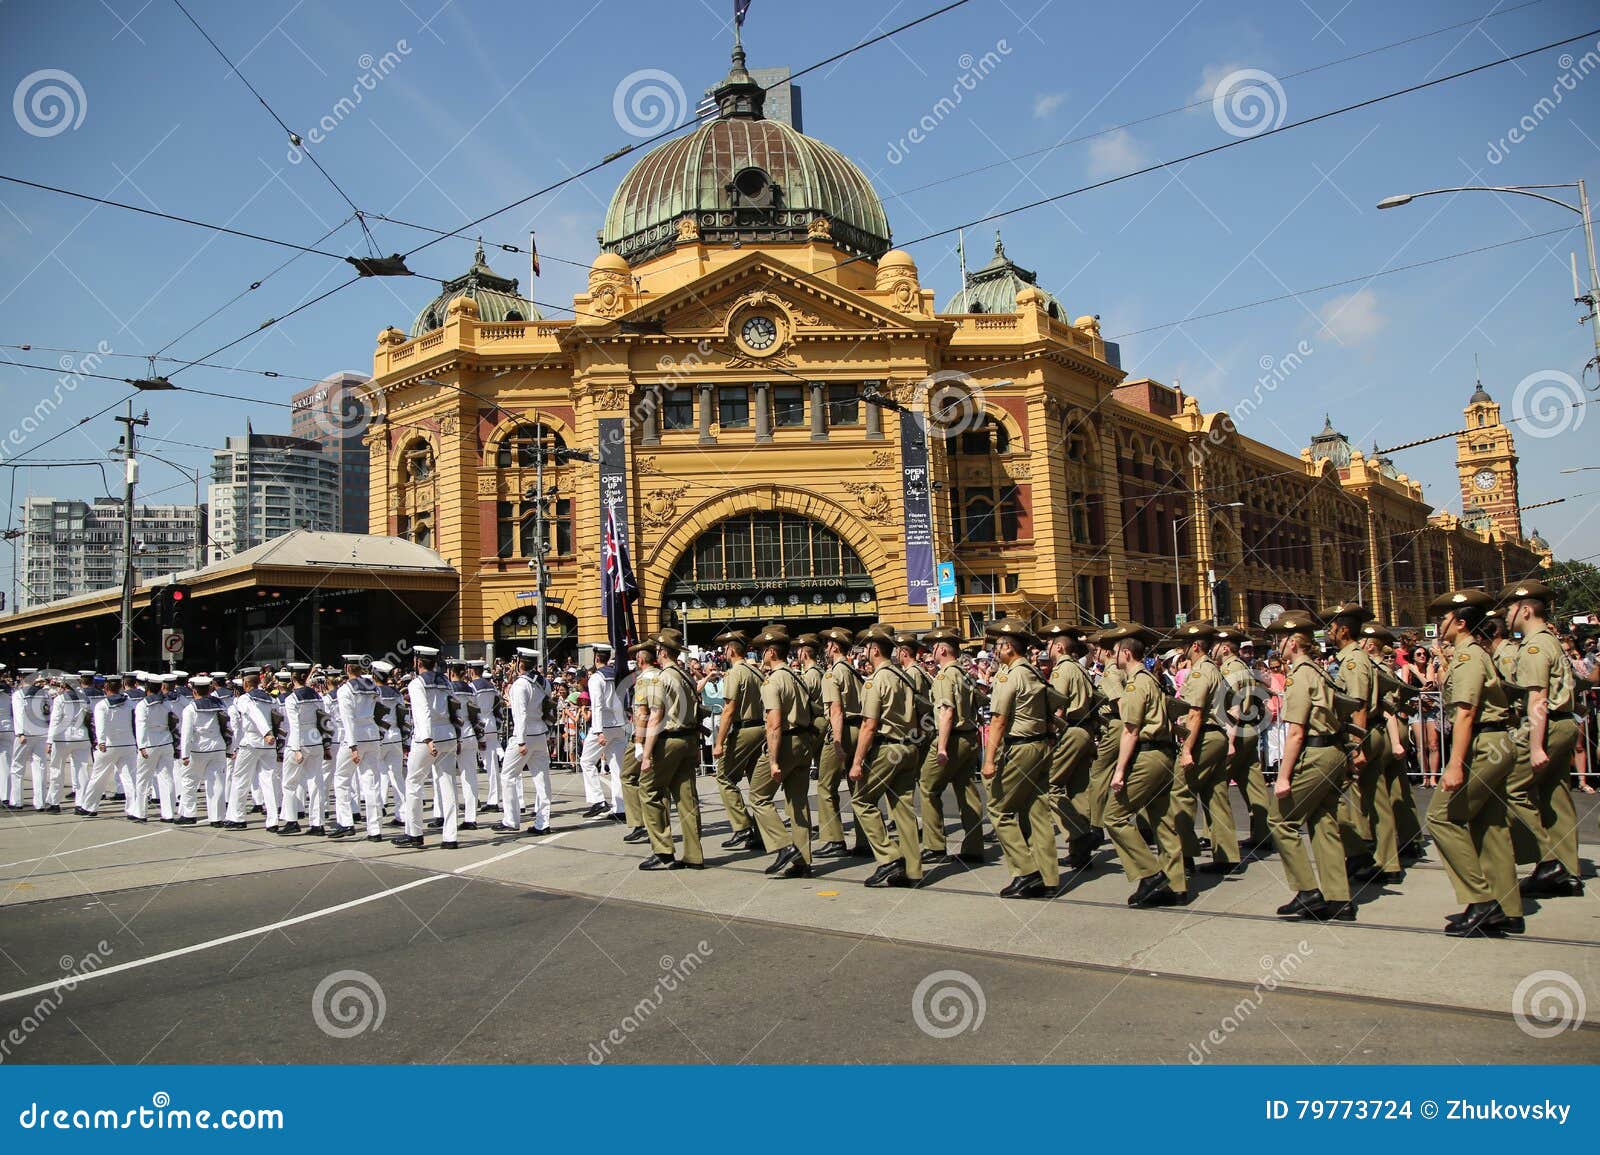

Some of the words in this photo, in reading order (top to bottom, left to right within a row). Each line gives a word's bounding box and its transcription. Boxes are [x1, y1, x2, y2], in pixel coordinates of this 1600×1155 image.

[695, 583, 742, 591] FLINDERS
[755, 581, 789, 589] STREET
[800, 579, 843, 588] STATION
